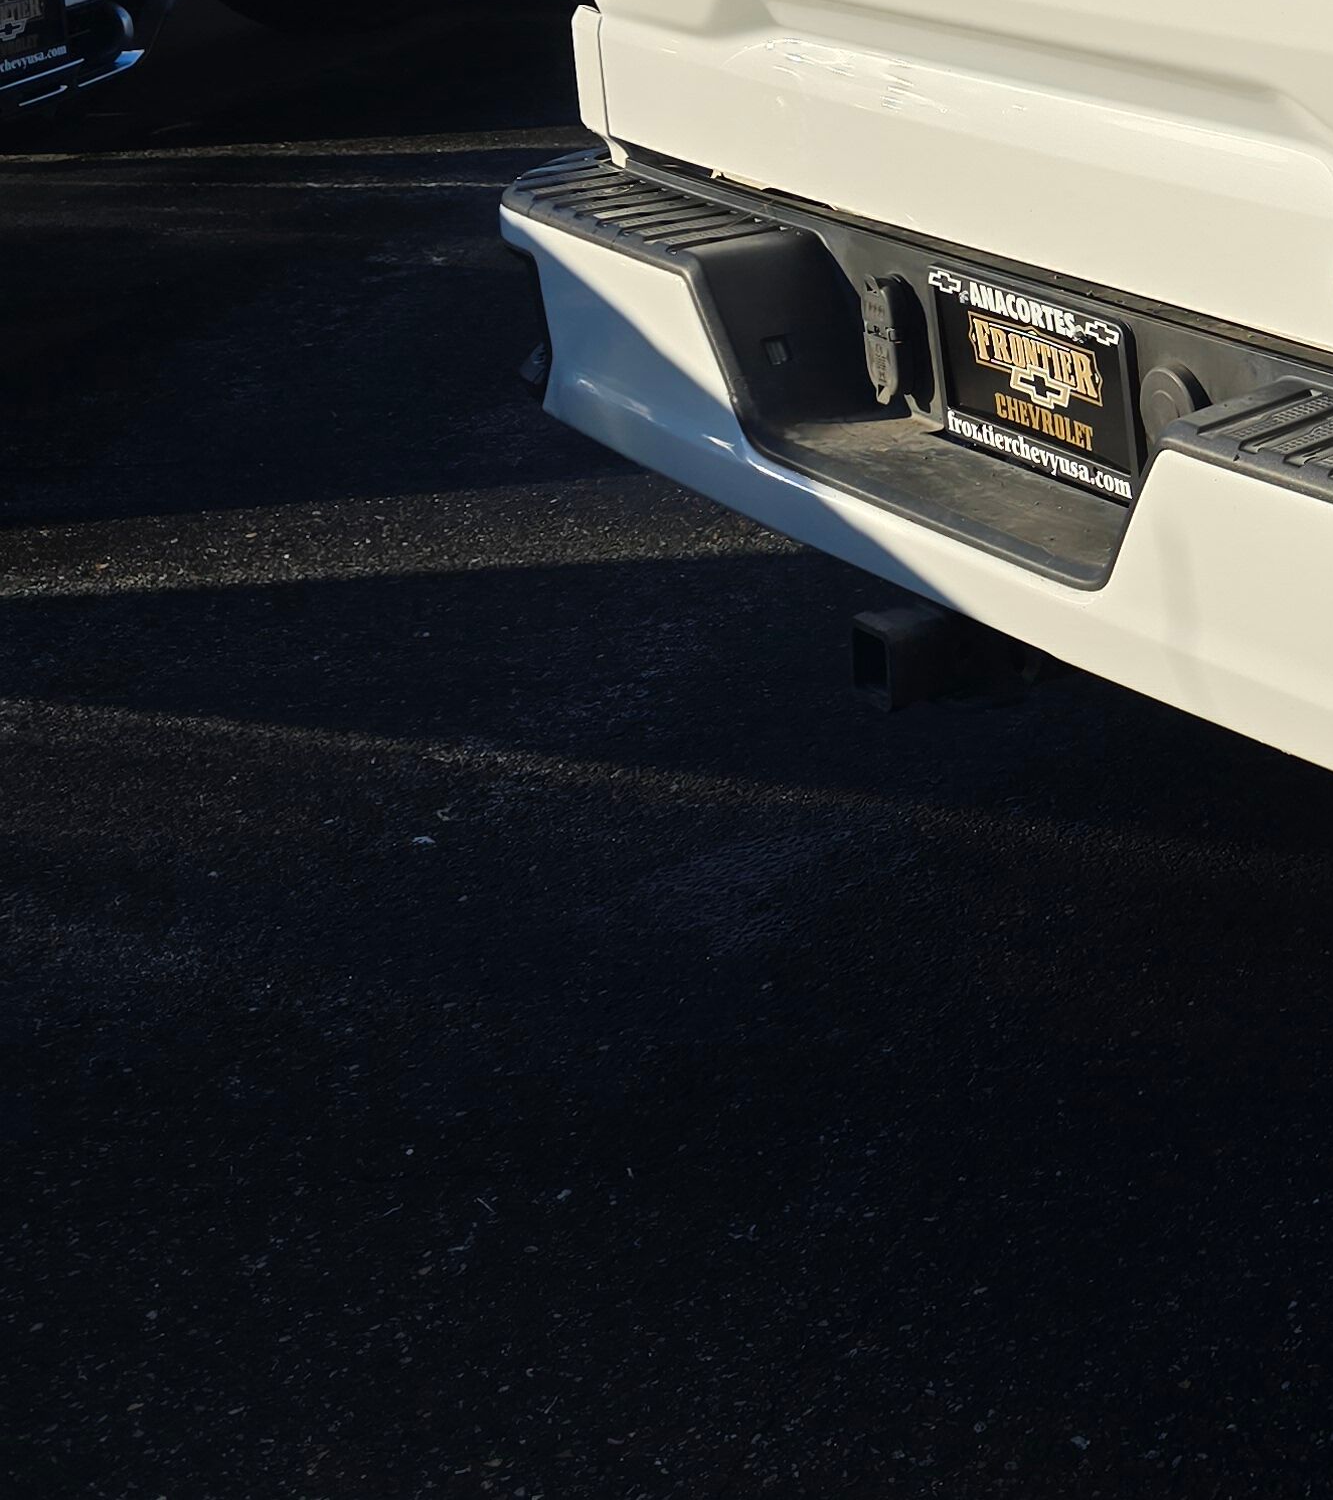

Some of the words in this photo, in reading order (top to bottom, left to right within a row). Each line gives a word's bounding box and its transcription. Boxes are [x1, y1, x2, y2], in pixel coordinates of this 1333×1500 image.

[969, 281, 1077, 339] ANACORTES
[973, 318, 1098, 398] FRONTIER
[947, 410, 1133, 500] frontierchevyusa.com
[994, 392, 1094, 451] CHEVROLET
